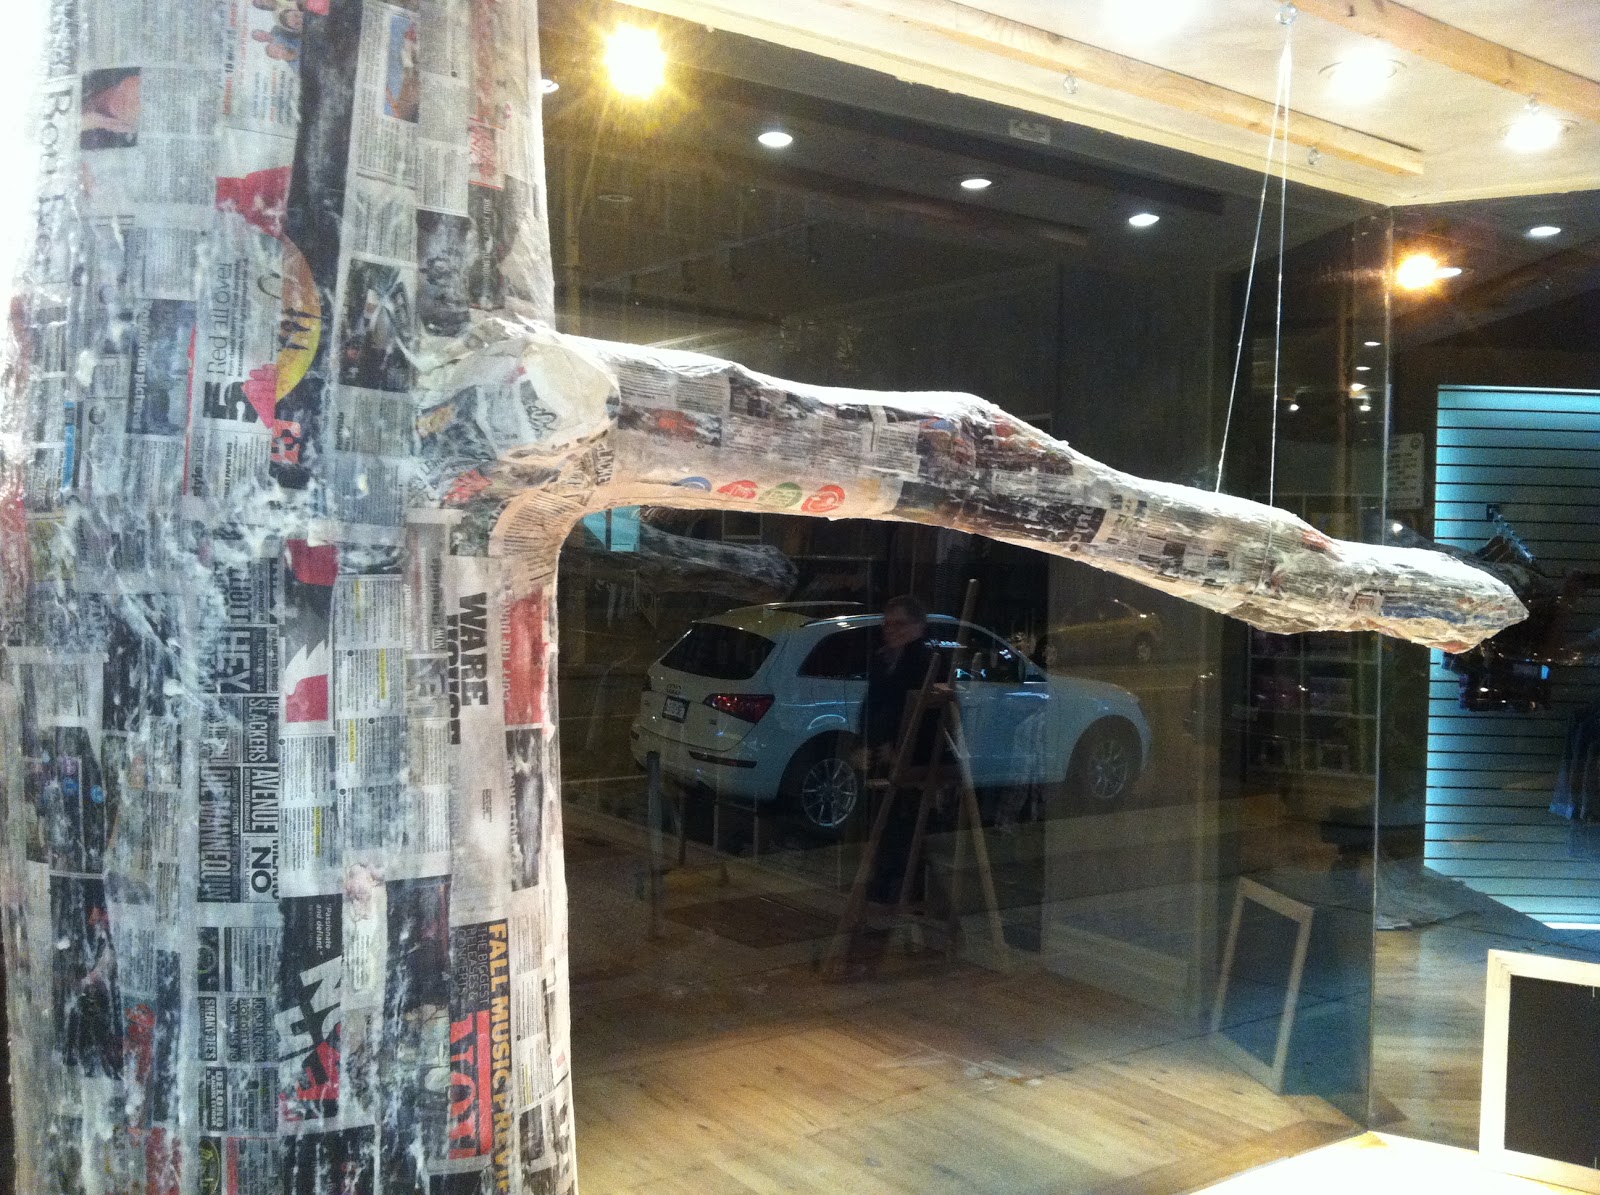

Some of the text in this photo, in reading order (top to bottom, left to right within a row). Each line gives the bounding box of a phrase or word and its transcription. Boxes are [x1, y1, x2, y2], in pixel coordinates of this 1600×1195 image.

[208, 307, 230, 334] all
[206, 335, 227, 375] Red
[202, 381, 259, 424] 5
[191, 435, 205, 497] stylenotes
[224, 458, 232, 478] PAPER
[431, 627, 445, 649] NOW
[459, 591, 489, 706] WARE
[501, 637, 511, 662] THE
[217, 630, 251, 692] HEY
[267, 699, 280, 715] THE
[247, 698, 268, 762] SLACKERS
[199, 768, 231, 798] DIE
[251, 767, 280, 832] AVENUE
[231, 802, 240, 835] OCTOBER
[197, 800, 231, 903] MANNEQUIN
[243, 852, 251, 869] PUNK
[251, 846, 272, 894] NO
[316, 903, 324, 919] and
[456, 928, 468, 996] CONCERTS
[465, 928, 478, 989] RELEASES
[477, 926, 490, 1004] THE BIGGEST
[488, 923, 508, 992] FALL
[203, 998, 217, 1033] SNEAKY
[230, 1047, 241, 1061] NO
[491, 995, 511, 1087] MUSIC
[215, 1069, 225, 1128] DELORO
